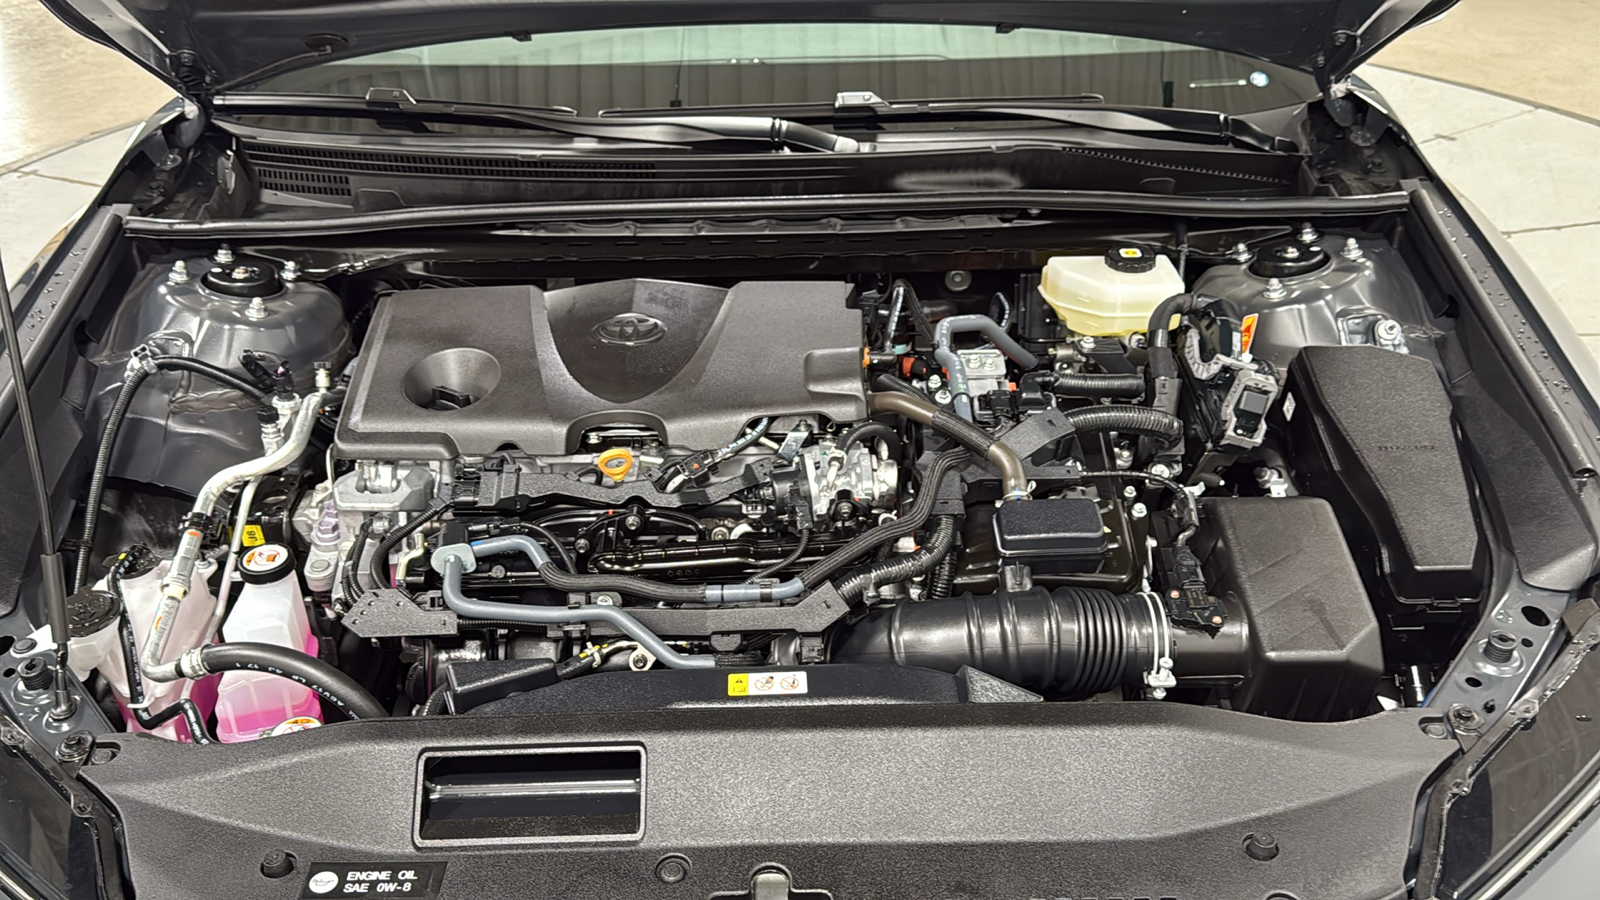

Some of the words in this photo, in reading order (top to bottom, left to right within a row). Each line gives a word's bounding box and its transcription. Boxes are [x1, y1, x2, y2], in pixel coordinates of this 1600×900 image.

[346, 871, 392, 881] ENGINE
[397, 870, 418, 880] OIL
[342, 883, 370, 893] SAE
[376, 882, 412, 893] 0W-8
